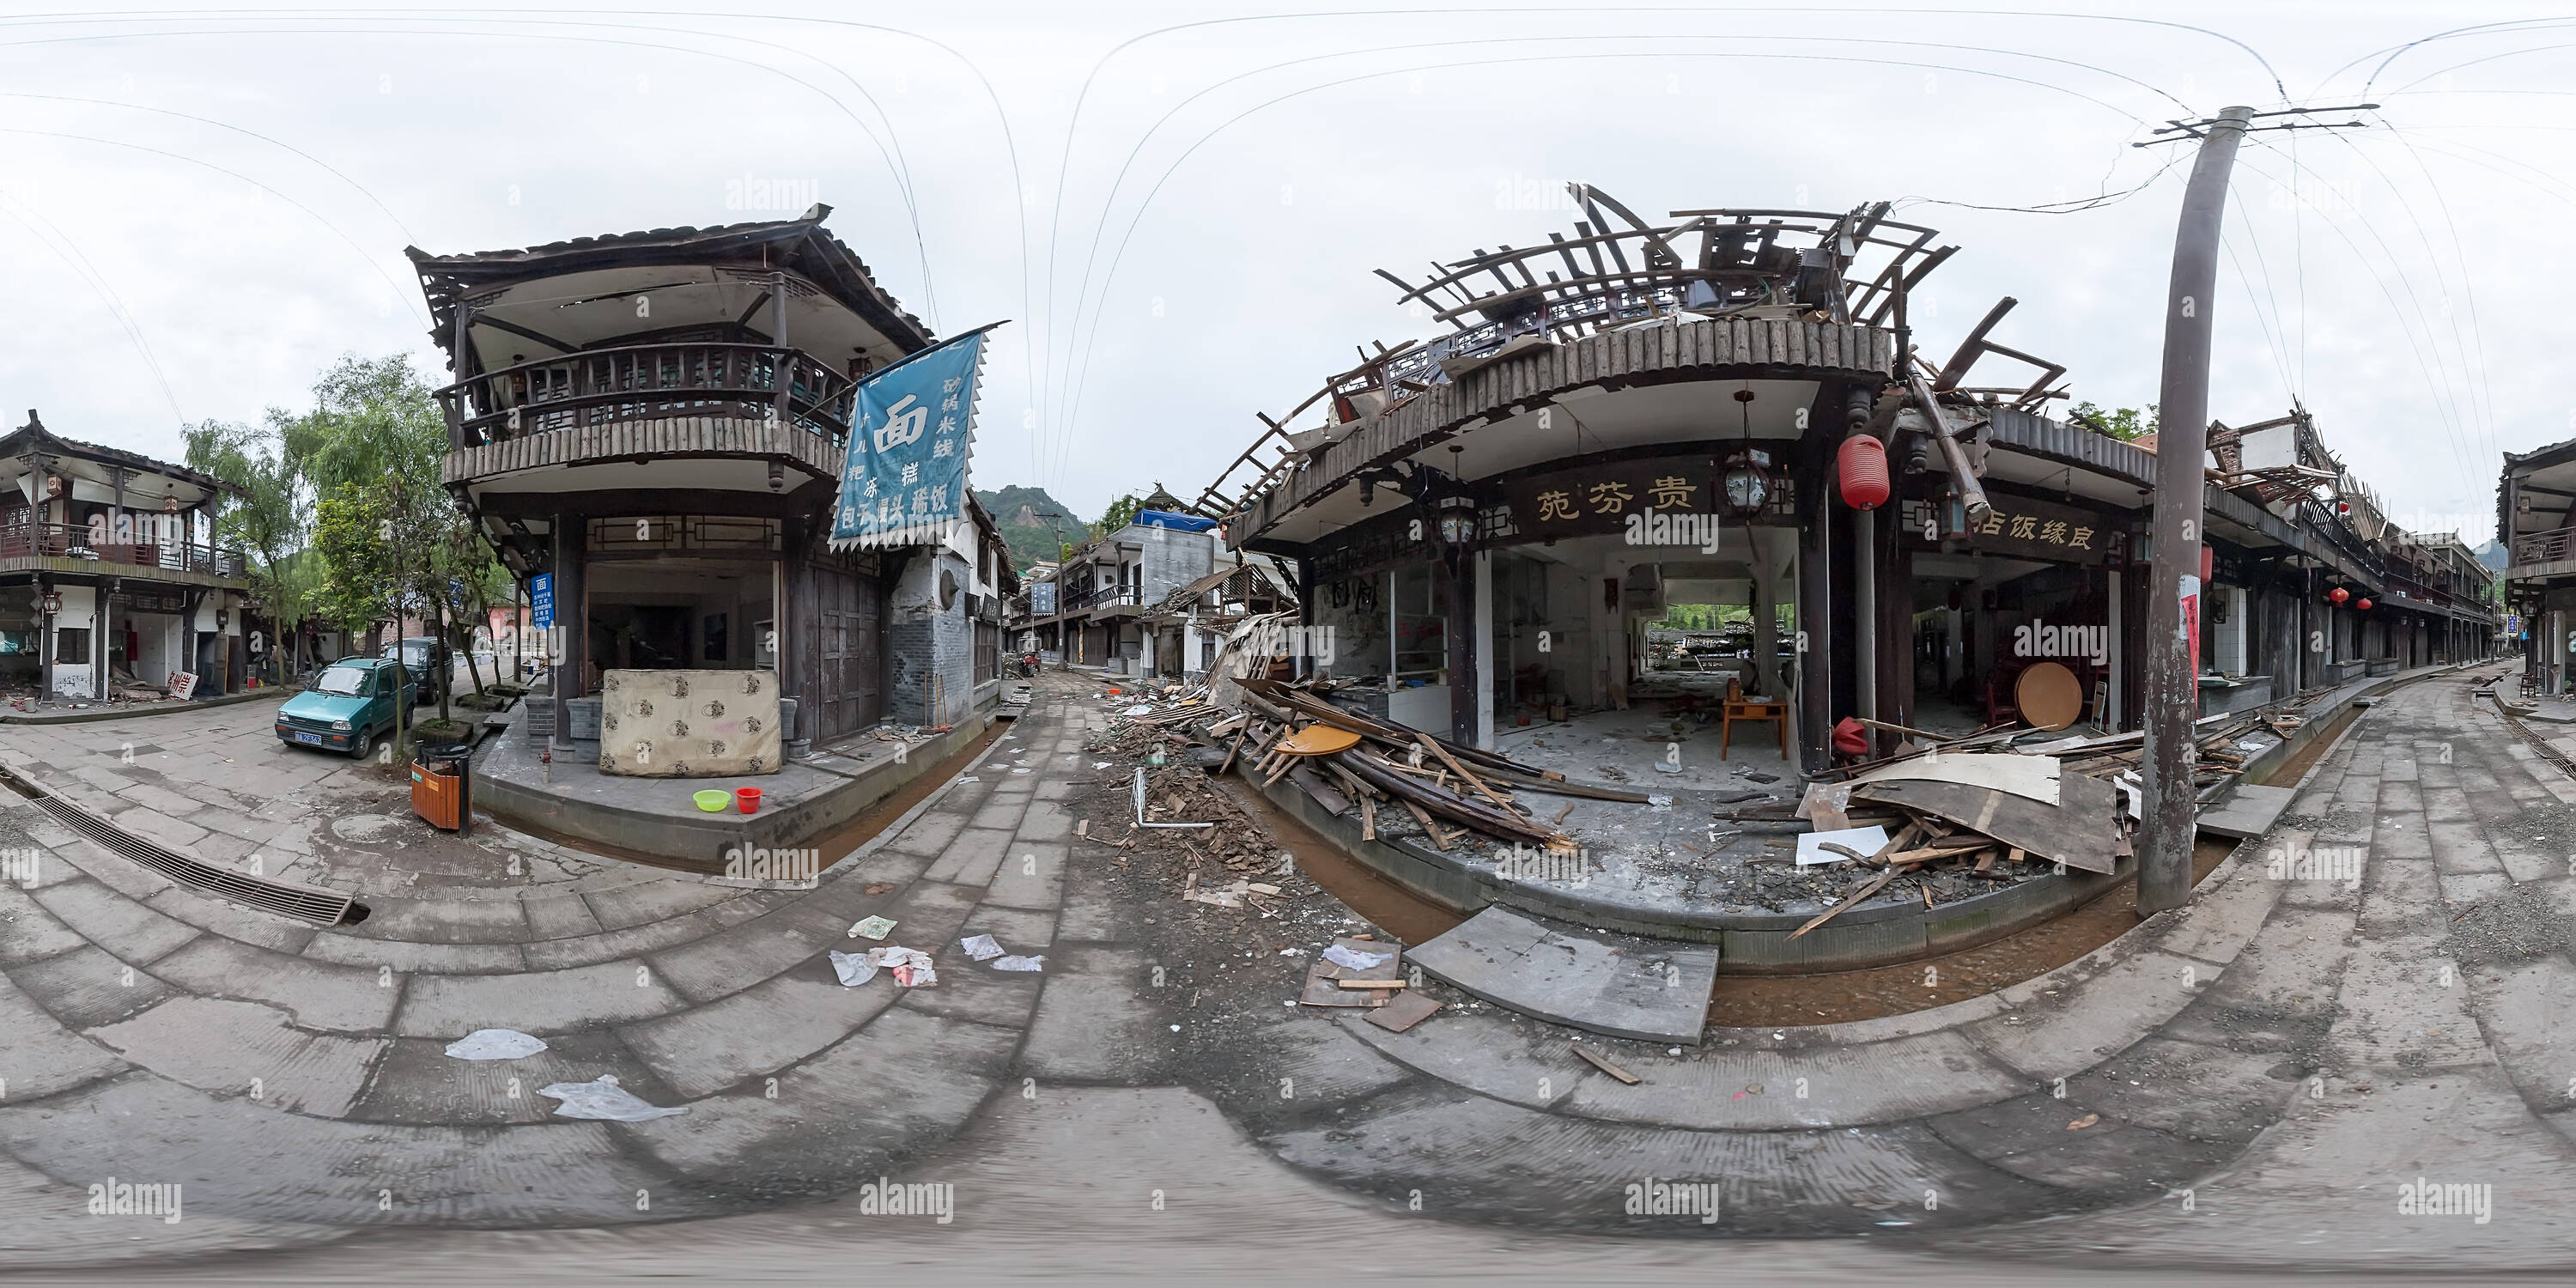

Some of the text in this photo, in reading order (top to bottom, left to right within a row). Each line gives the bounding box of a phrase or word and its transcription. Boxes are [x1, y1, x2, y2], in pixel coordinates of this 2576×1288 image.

[873, 393, 928, 455] 面
[933, 376, 962, 459] 砂锅米线
[536, 577, 547, 592] 面
